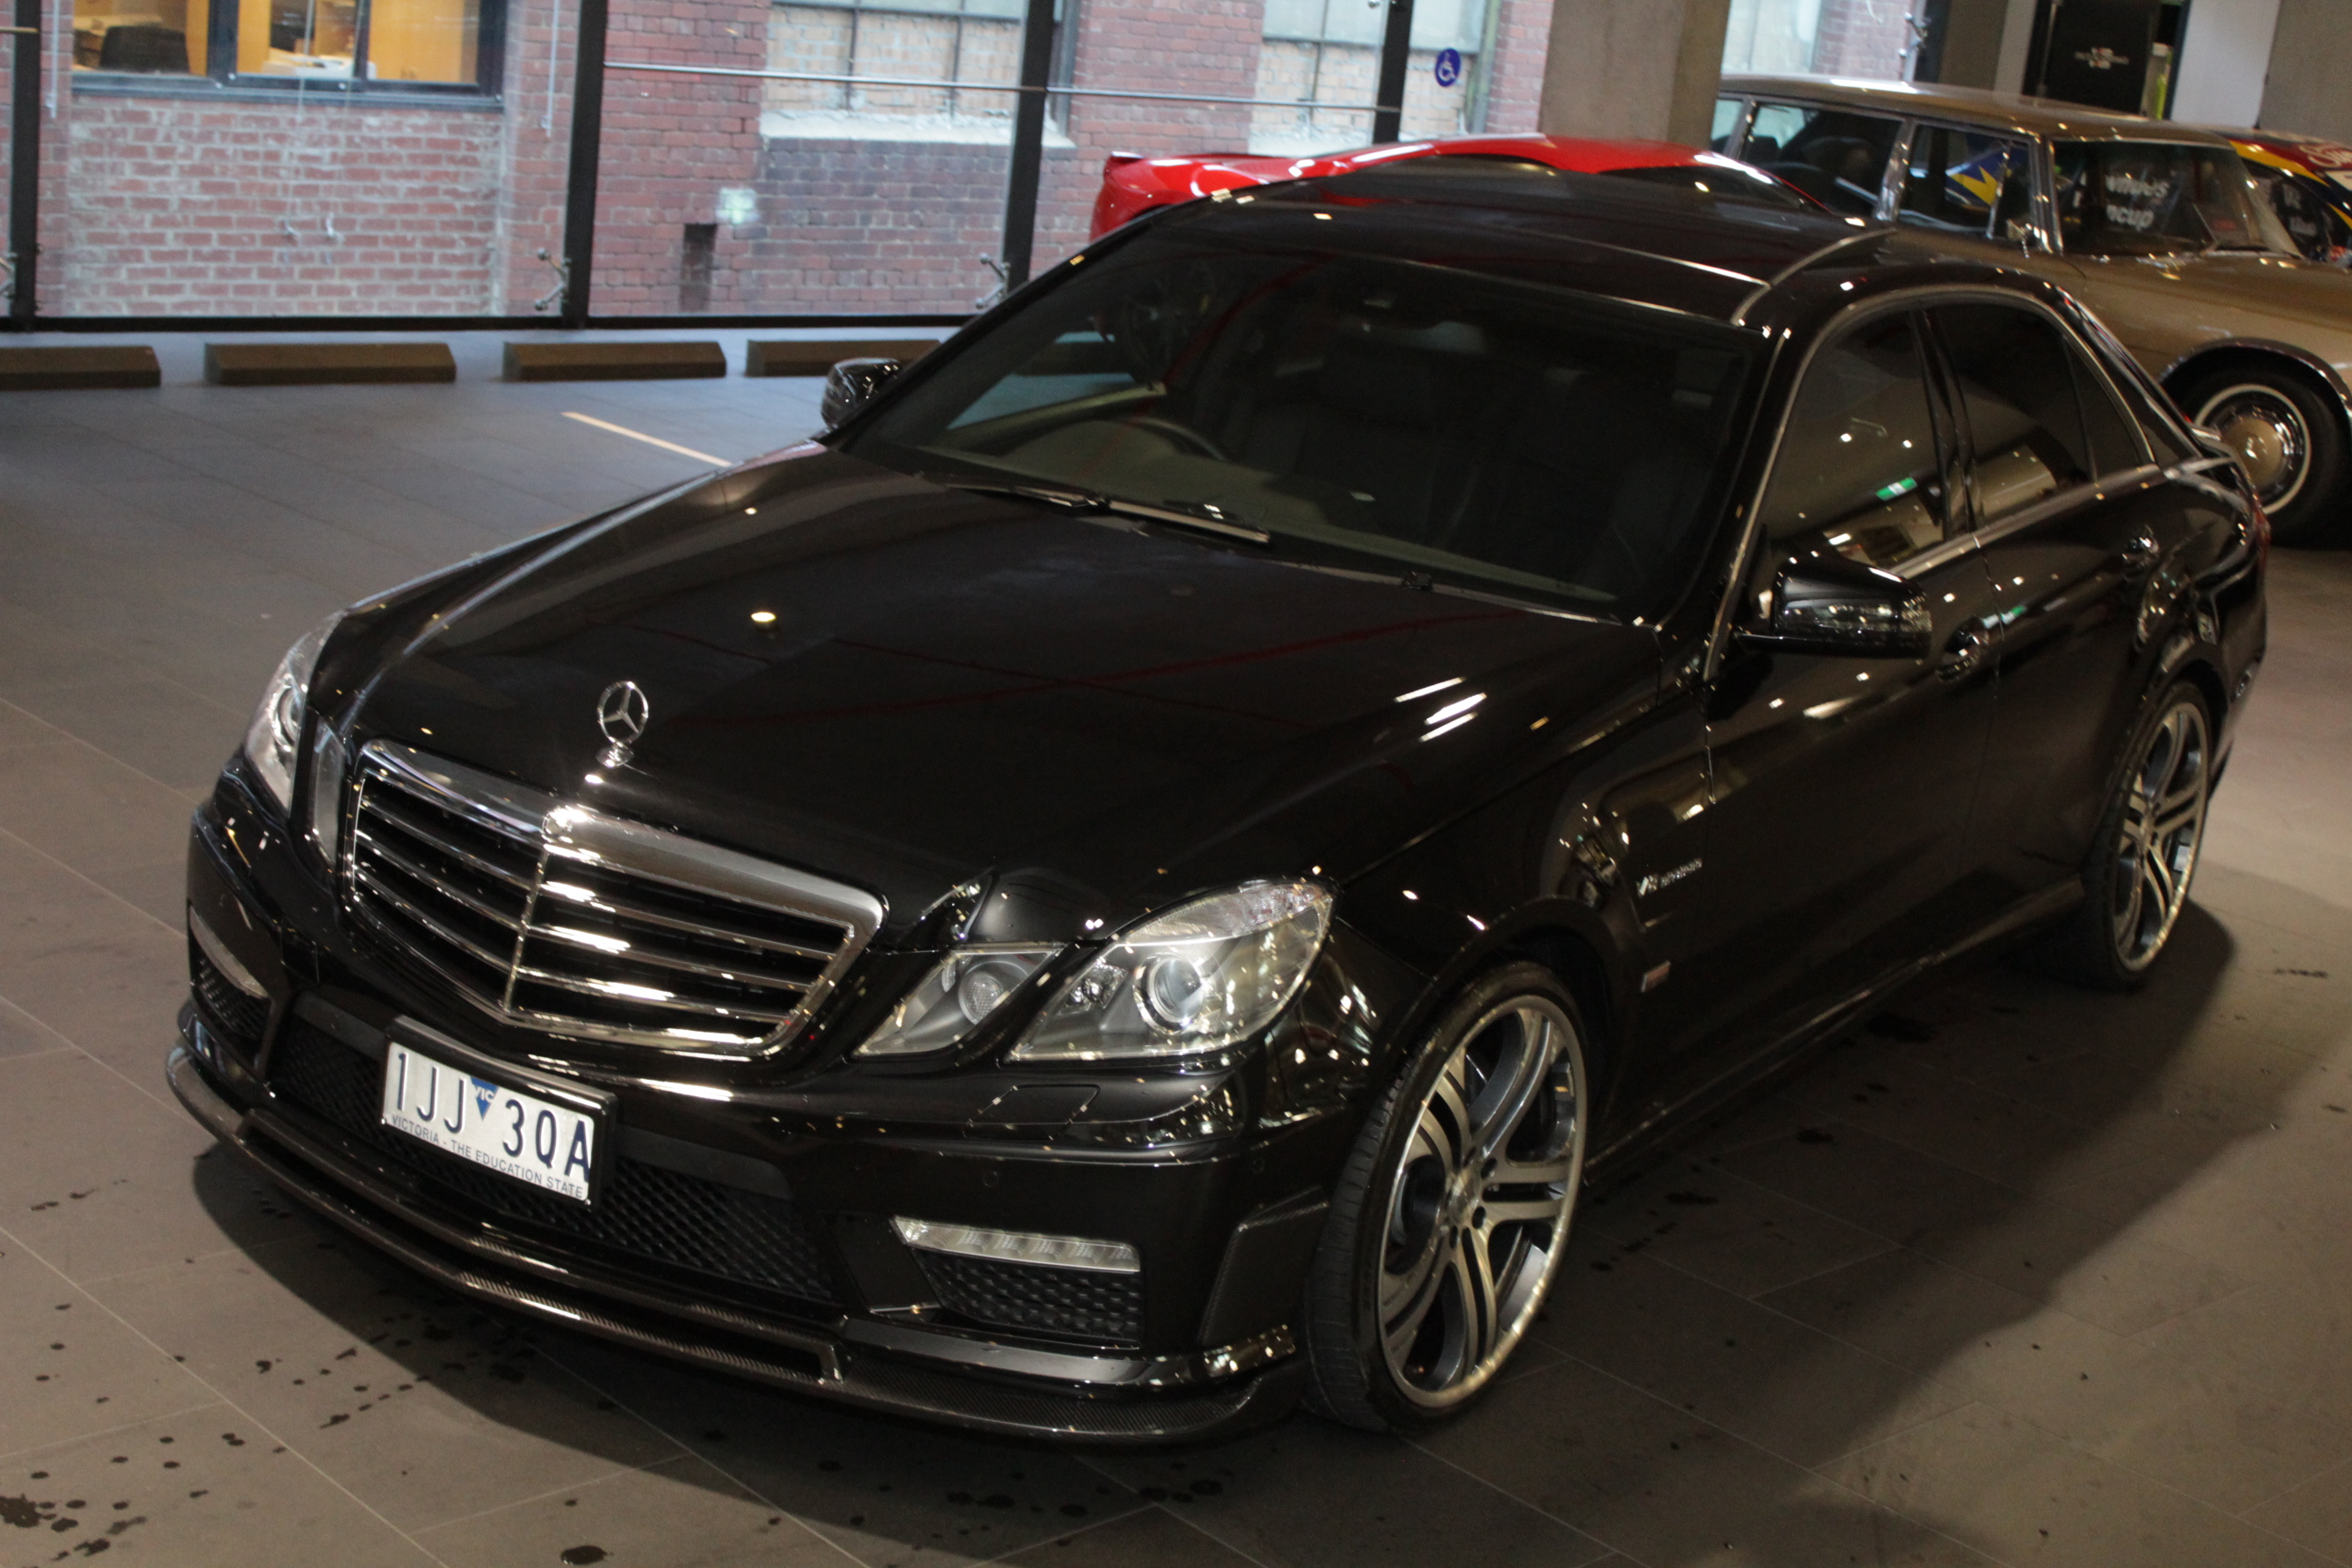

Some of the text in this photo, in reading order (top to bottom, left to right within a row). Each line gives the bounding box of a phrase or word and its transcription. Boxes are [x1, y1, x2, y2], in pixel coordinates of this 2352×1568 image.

[475, 1084, 495, 1104] VIC
[392, 1113, 440, 1145] VICTORIA
[450, 1138, 473, 1159] THE
[475, 1149, 543, 1185] EDUCATION
[546, 1176, 583, 1199] STATE
